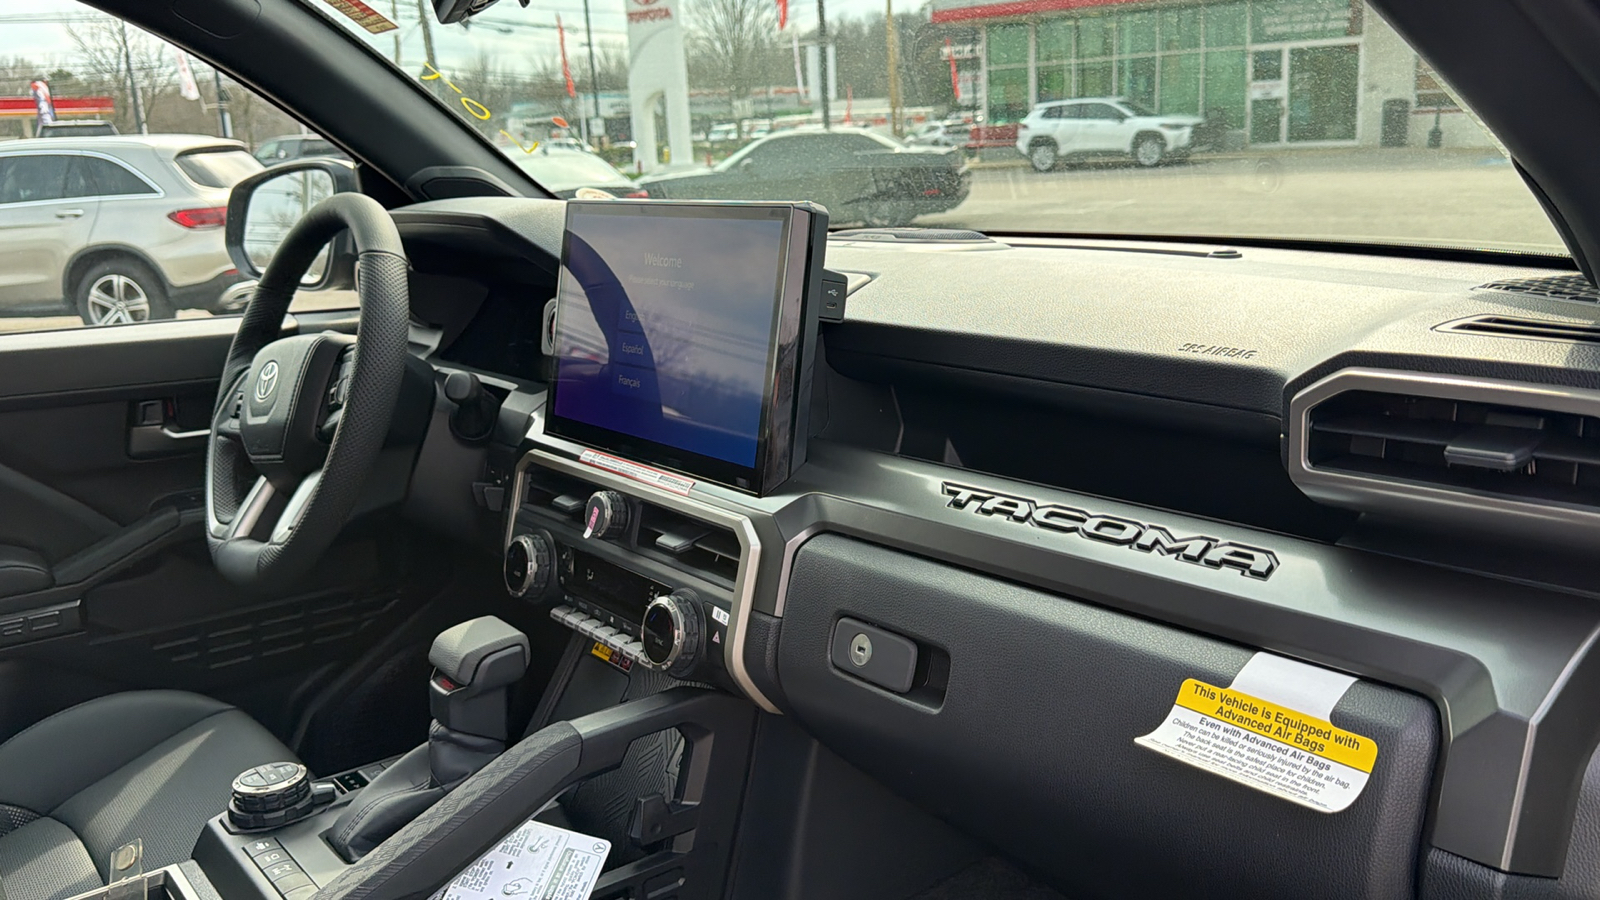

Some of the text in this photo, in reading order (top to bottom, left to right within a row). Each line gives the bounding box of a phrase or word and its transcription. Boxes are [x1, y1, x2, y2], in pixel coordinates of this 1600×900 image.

[627, 7, 673, 23] TOYOTA
[644, 252, 682, 268] Welcome
[622, 342, 644, 356] Español
[1202, 346, 1258, 359] AIRBAG
[618, 374, 641, 388] Français
[941, 481, 1281, 581] TACOMA
[1193, 684, 1360, 751] This Vehicle is Equipped with
[1215, 706, 1325, 753] Advanced Air Bags
[1172, 717, 1351, 790] Children can be killed or seriously injured by the air bag.
[1183, 731, 1196, 740] The
[1196, 736, 1211, 746] back
[1211, 741, 1227, 752] seat
[1234, 749, 1245, 758] the
[1245, 754, 1267, 767] safest
[1265, 762, 1286, 773] place
[1286, 769, 1297, 778] for
[1297, 774, 1326, 790] children.
[1199, 717, 1332, 771] Even with Advanced Air Bags
